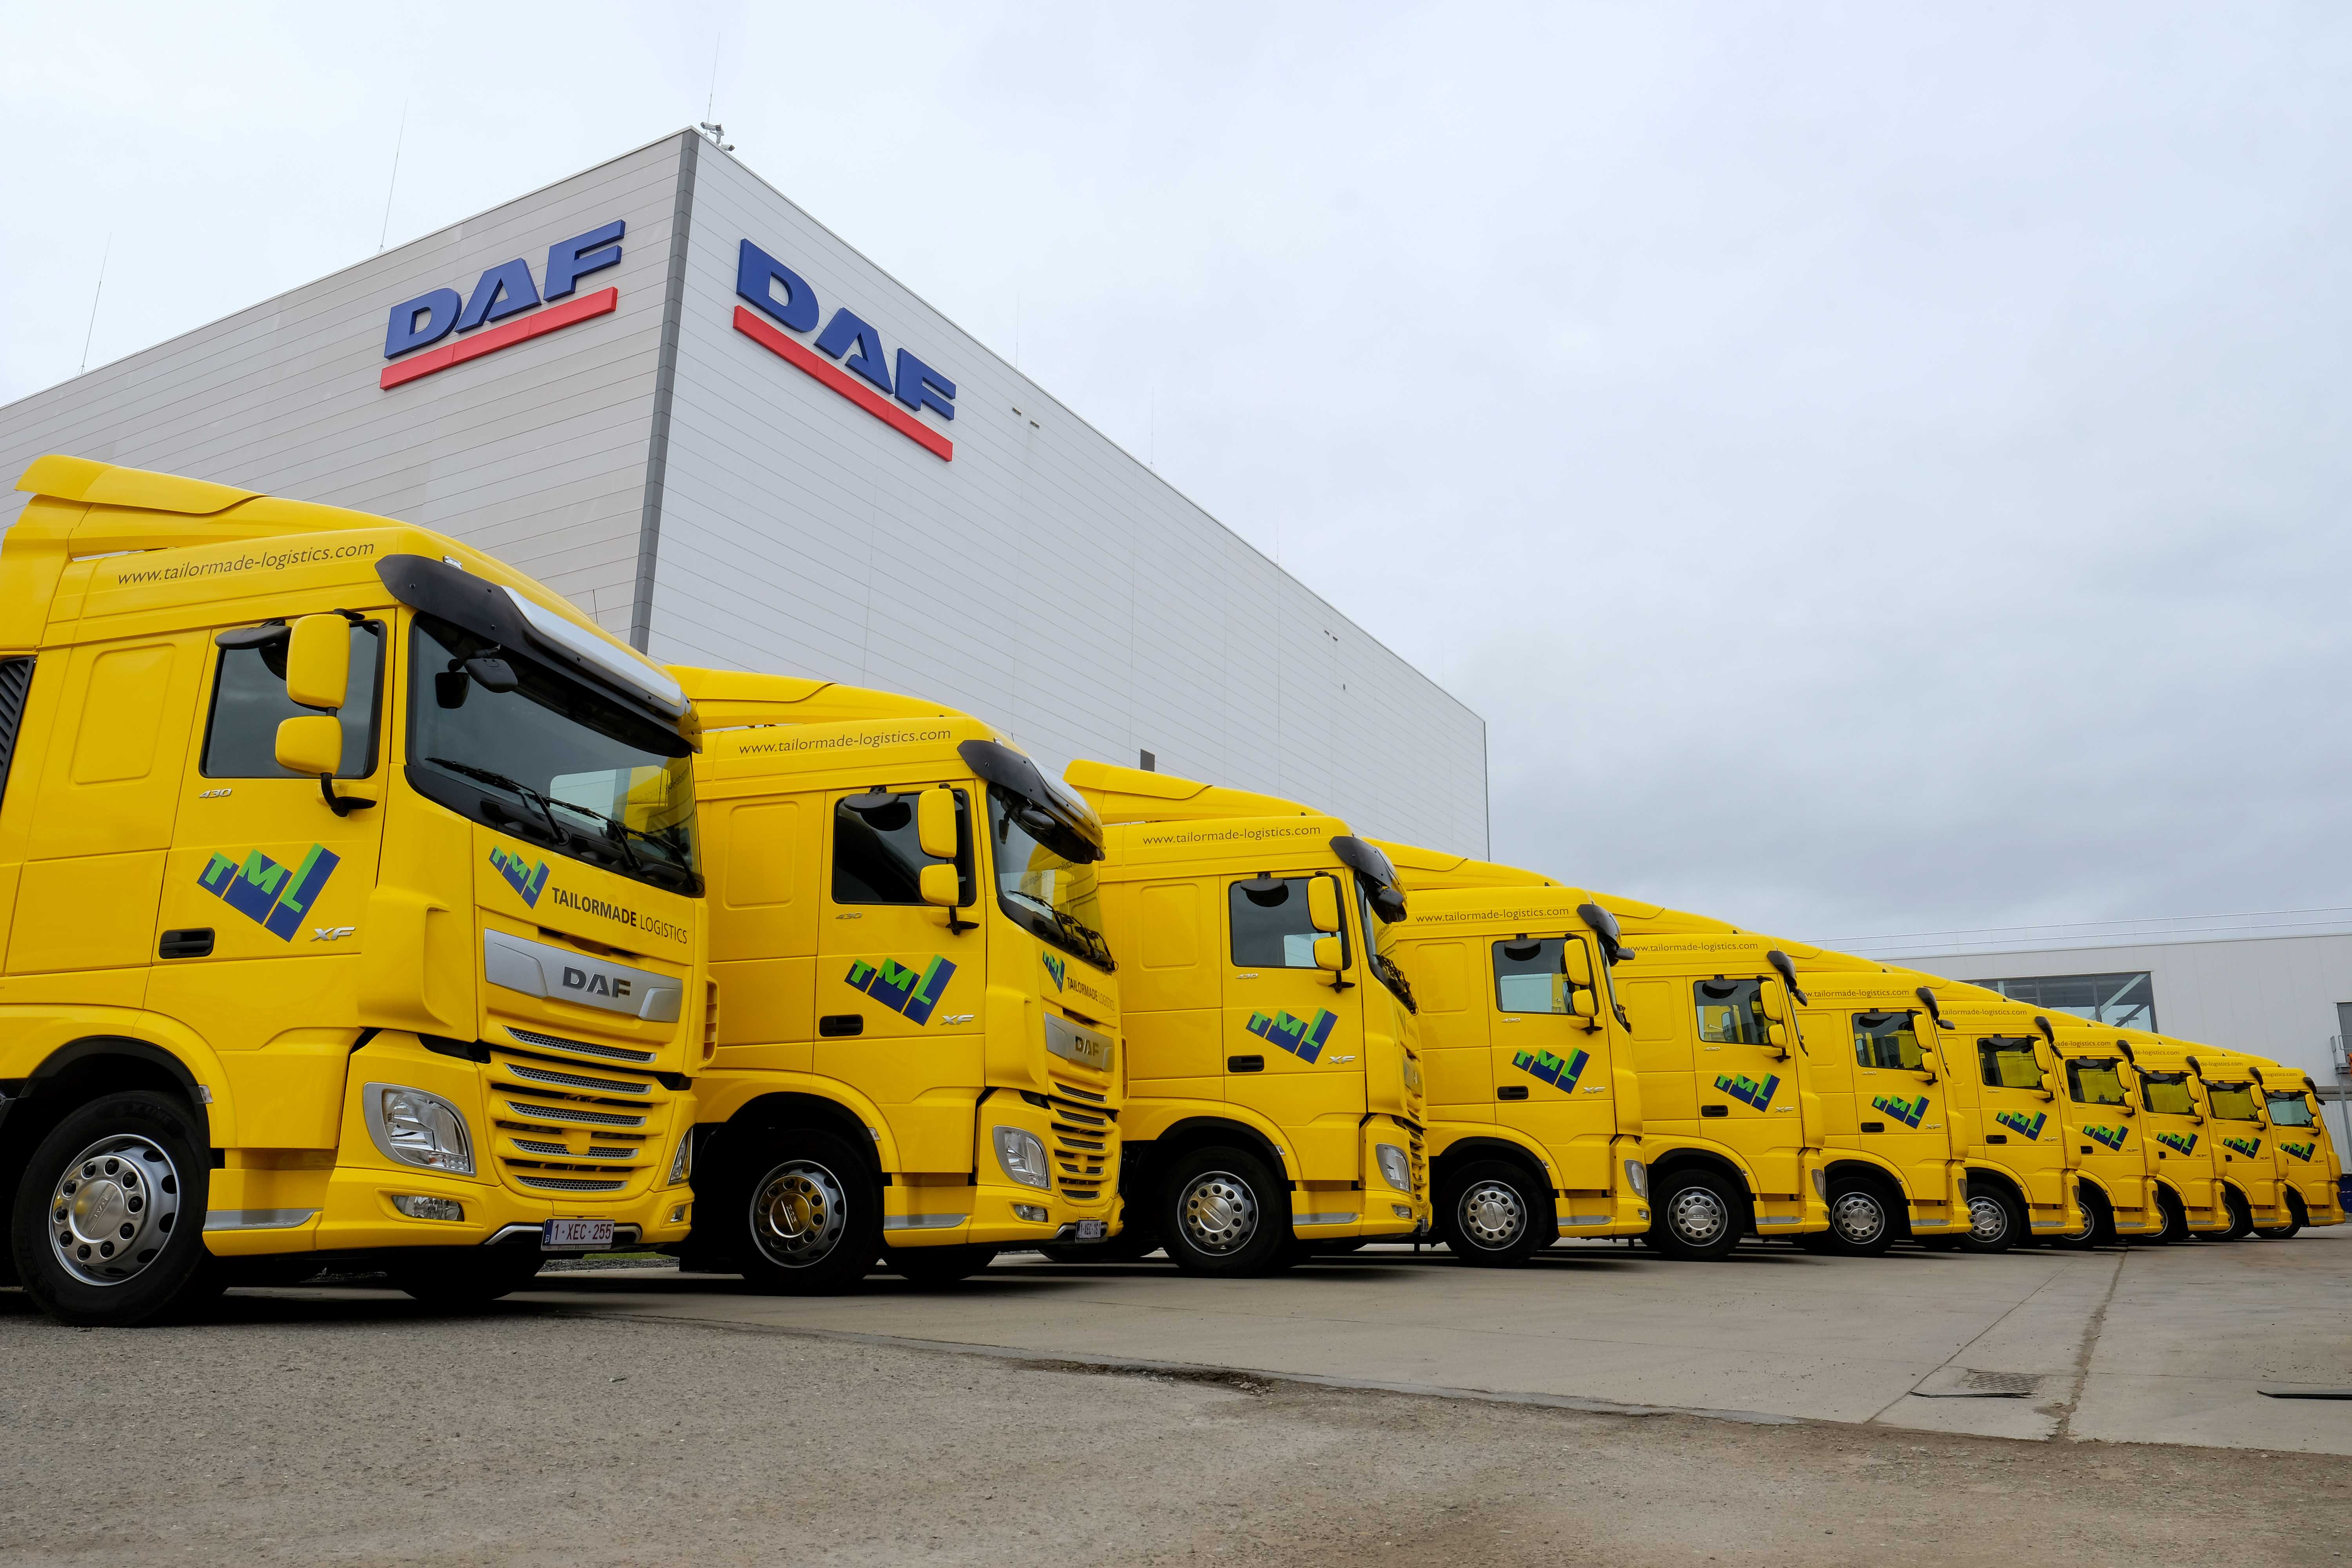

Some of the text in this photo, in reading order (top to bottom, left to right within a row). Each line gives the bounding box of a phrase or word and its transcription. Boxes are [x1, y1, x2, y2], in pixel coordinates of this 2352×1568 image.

[384, 219, 626, 360] DAF
[736, 238, 956, 421] DAF
[118, 542, 375, 585] www.tailormade-logistics.com
[739, 728, 951, 754] www.tailormade-logistics.com
[199, 788, 232, 799] 430
[1143, 826, 1321, 845] www.tailormade-logistics.com
[204, 843, 325, 913] TML
[492, 845, 544, 895] TML
[552, 887, 687, 944] TAILORMADE LOGISTICS
[835, 912, 862, 920] 430
[1416, 907, 1569, 923] www.tailormade-logistics.com
[310, 927, 356, 942] XF
[562, 965, 631, 998] DAF
[850, 954, 944, 1005] TML
[1067, 977, 1114, 1011] TAILORMADE LOGISTICS
[1792, 989, 1909, 998] w.tailormade-logistics.com
[940, 1014, 975, 1025] XF
[1251, 1007, 1327, 1048] TML
[1075, 1035, 1100, 1056] DAF
[1327, 1056, 1356, 1064] XF
[1515, 1048, 1581, 1082] TML
[1717, 1073, 1772, 1101] TML
[1874, 1095, 1923, 1120] TML
[1998, 1111, 2041, 1132] TML
[2084, 1125, 2123, 1145] TML
